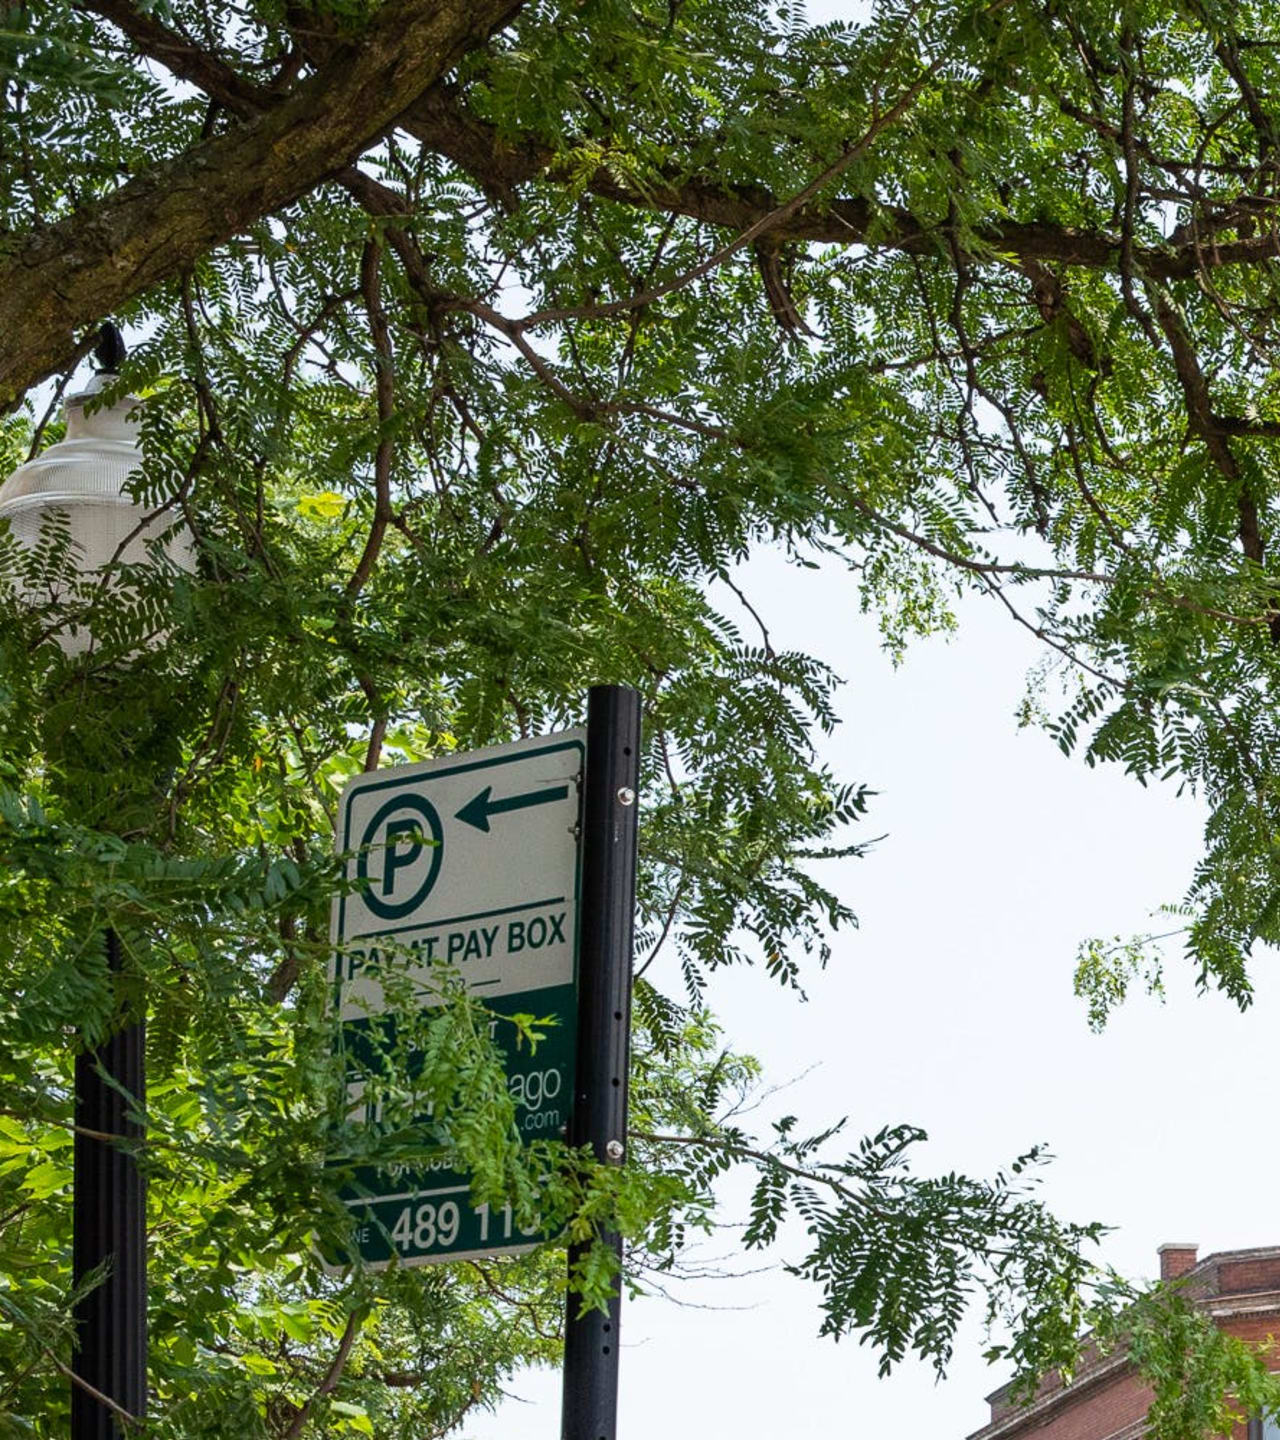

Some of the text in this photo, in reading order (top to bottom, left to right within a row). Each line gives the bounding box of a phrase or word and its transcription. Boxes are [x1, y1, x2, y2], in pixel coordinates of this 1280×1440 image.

[348, 944, 395, 980] PA
[448, 925, 500, 965] PAY
[507, 912, 567, 954] BOX
[391, 1201, 460, 1251] 489
